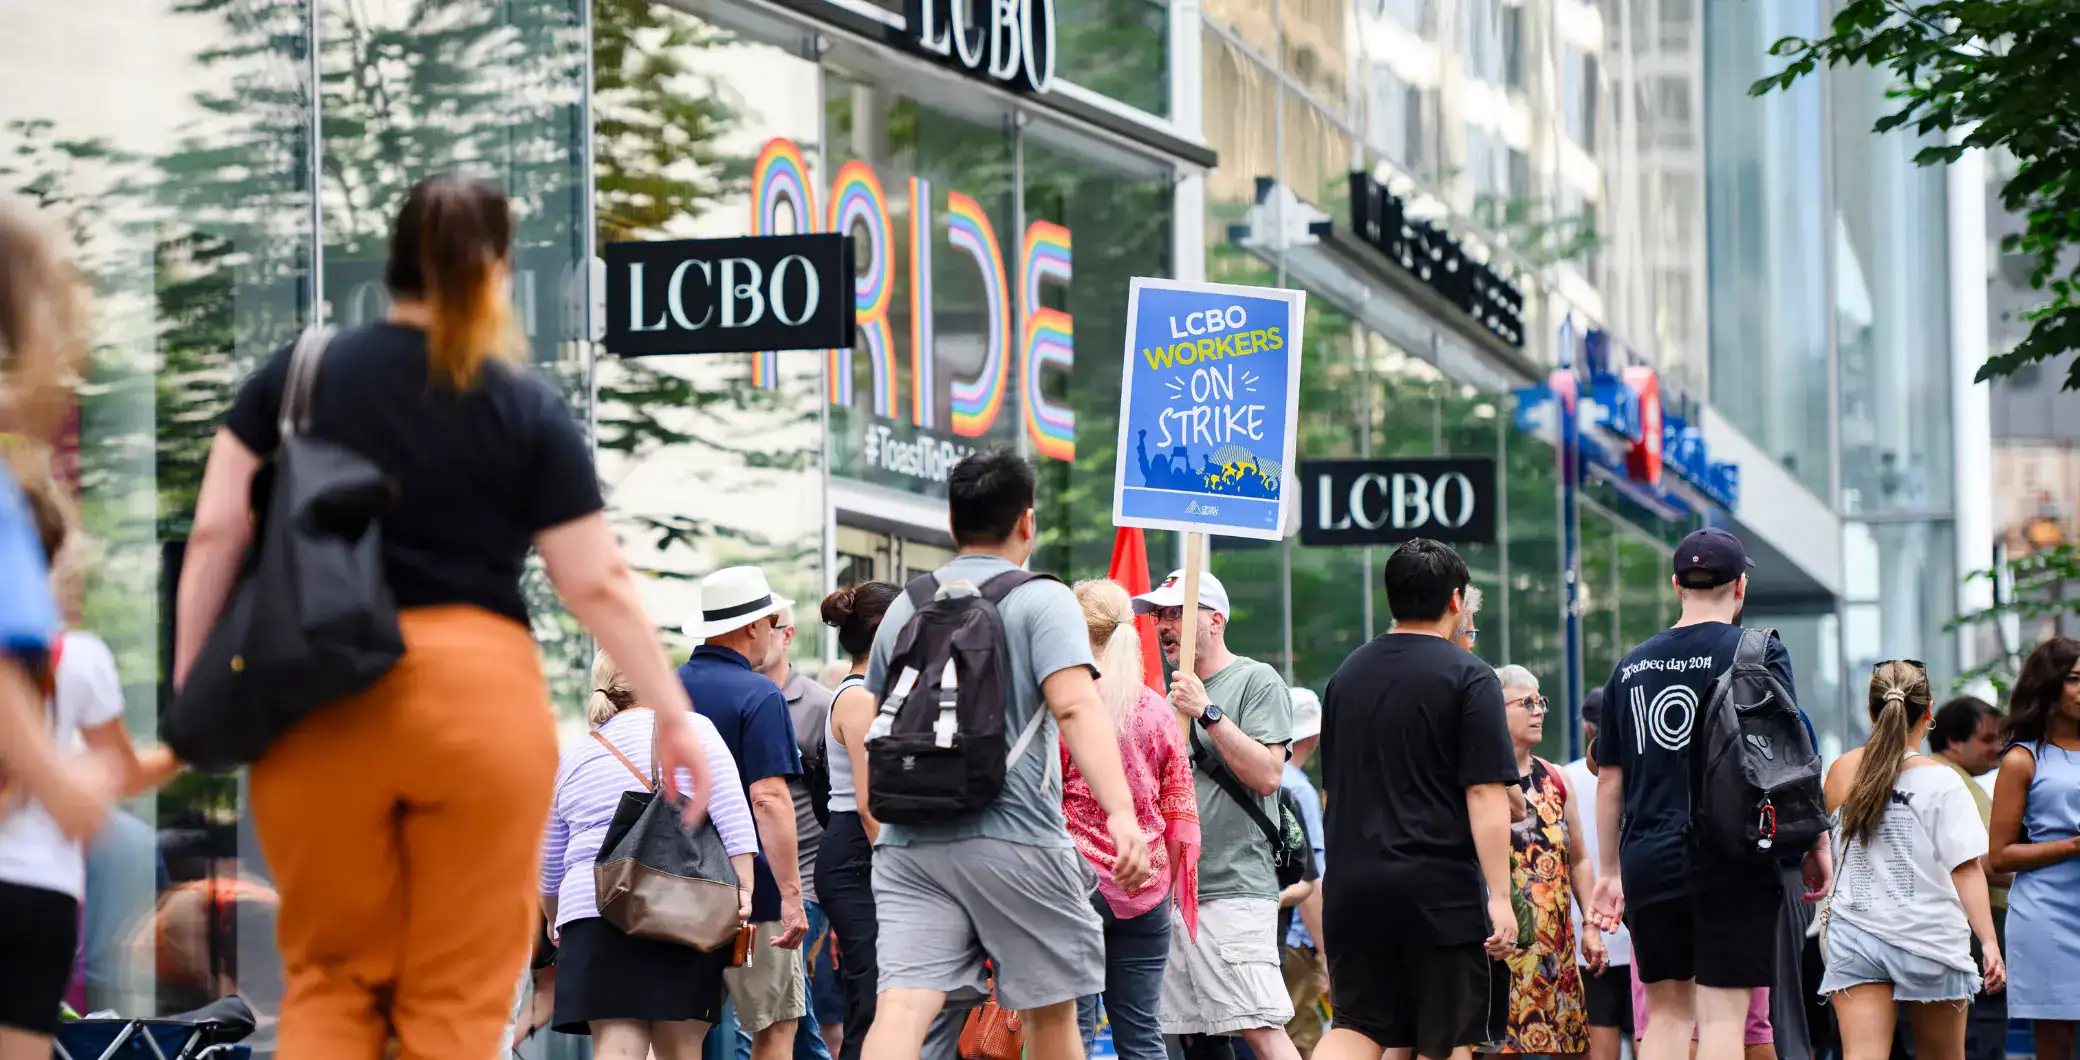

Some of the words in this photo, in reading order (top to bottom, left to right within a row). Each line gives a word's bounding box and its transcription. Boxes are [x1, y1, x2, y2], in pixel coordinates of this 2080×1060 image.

[628, 254, 820, 332] LCBO
[1169, 305, 1247, 339] LCBO
[1142, 327, 1284, 370] WORKERS
[1190, 363, 1234, 403] ON
[1156, 404, 1266, 448] STRIKE
[864, 423, 976, 483] #ToastToPr
[1318, 471, 1476, 530] LCBO
[1666, 657, 1687, 673] day
[1630, 684, 1698, 755] 10
